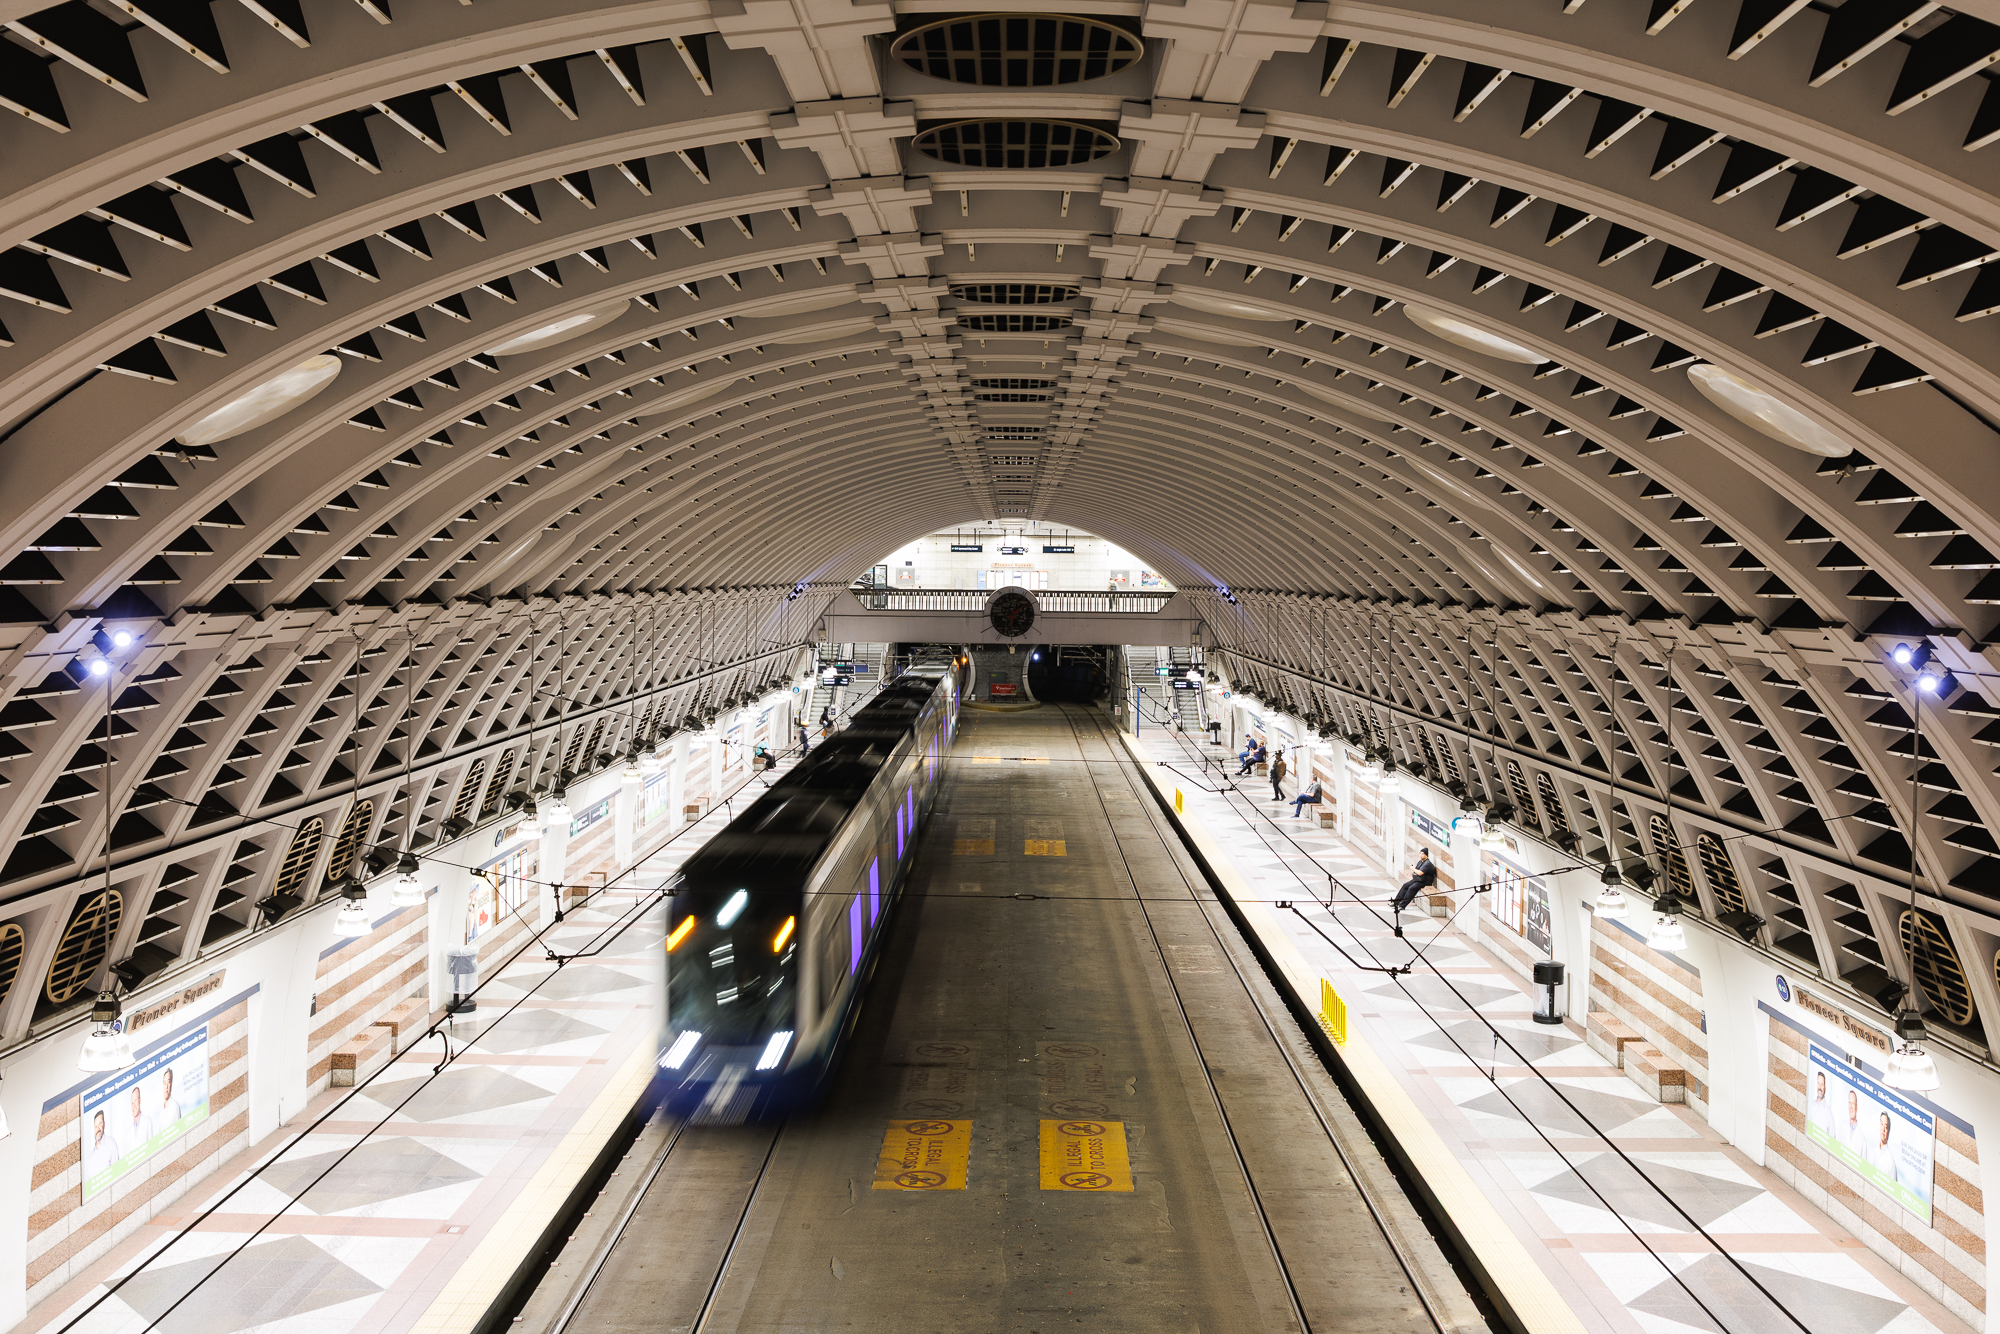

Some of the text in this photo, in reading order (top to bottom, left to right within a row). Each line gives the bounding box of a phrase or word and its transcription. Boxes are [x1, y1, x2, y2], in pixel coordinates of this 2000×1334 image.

[132, 976, 220, 1030] Pioneer Square
[1796, 990, 1885, 1050] Pioneer Square
[901, 1138, 922, 1170] TO CROSS
[924, 1139, 944, 1167] ILLEGAL
[1066, 1140, 1082, 1167] ILLEGAL
[1088, 1138, 1106, 1170] TO CROSS
